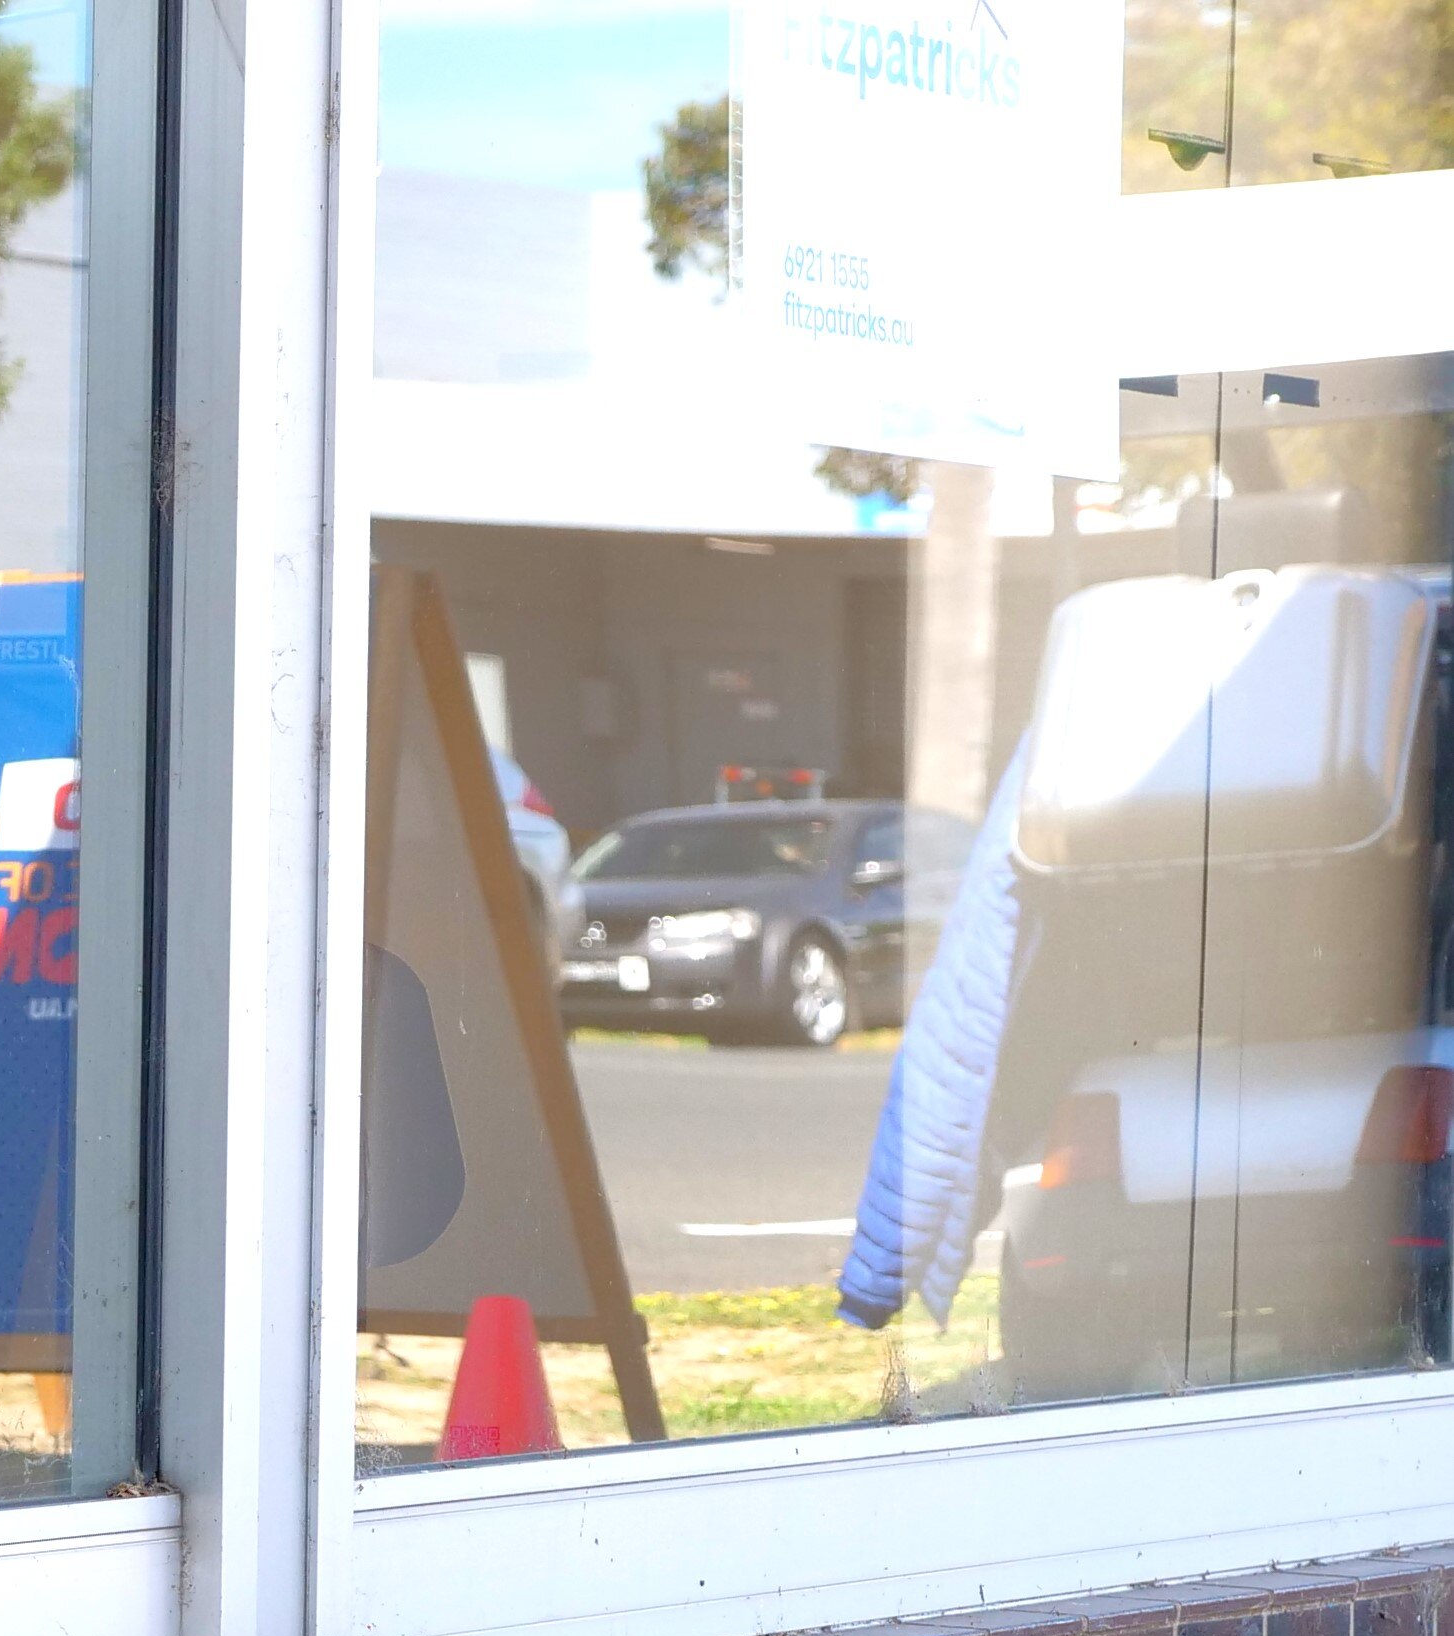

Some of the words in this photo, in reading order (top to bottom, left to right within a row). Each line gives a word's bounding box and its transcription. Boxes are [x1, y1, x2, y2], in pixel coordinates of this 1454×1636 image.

[784, 244, 823, 283] 6921
[830, 252, 869, 290] 1555
[783, 291, 913, 346] fitzpatricks.au
